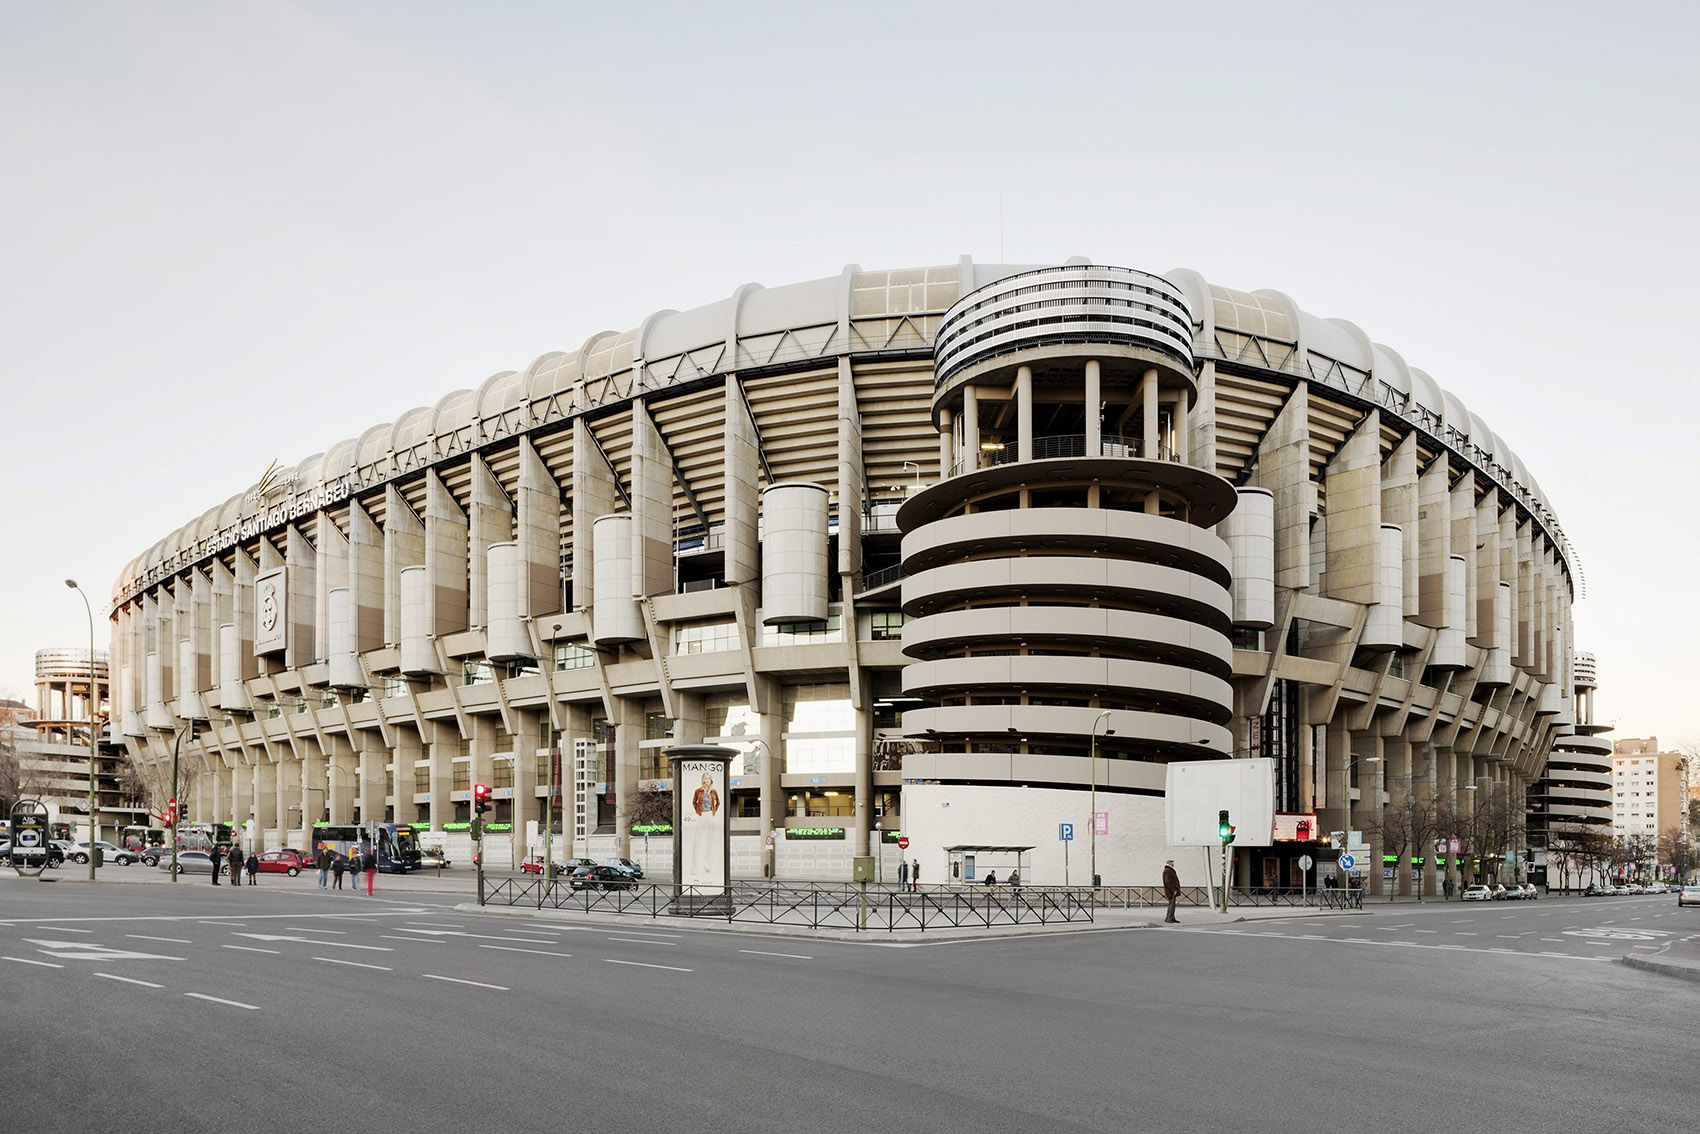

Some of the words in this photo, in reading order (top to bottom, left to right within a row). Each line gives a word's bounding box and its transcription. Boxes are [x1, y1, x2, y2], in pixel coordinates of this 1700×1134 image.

[206, 530, 239, 556] ESTADIO
[241, 508, 288, 541] SANTIAGO
[289, 482, 350, 520] BERNABEU
[683, 763, 723, 772] MANGO
[1063, 825, 1071, 838] P
